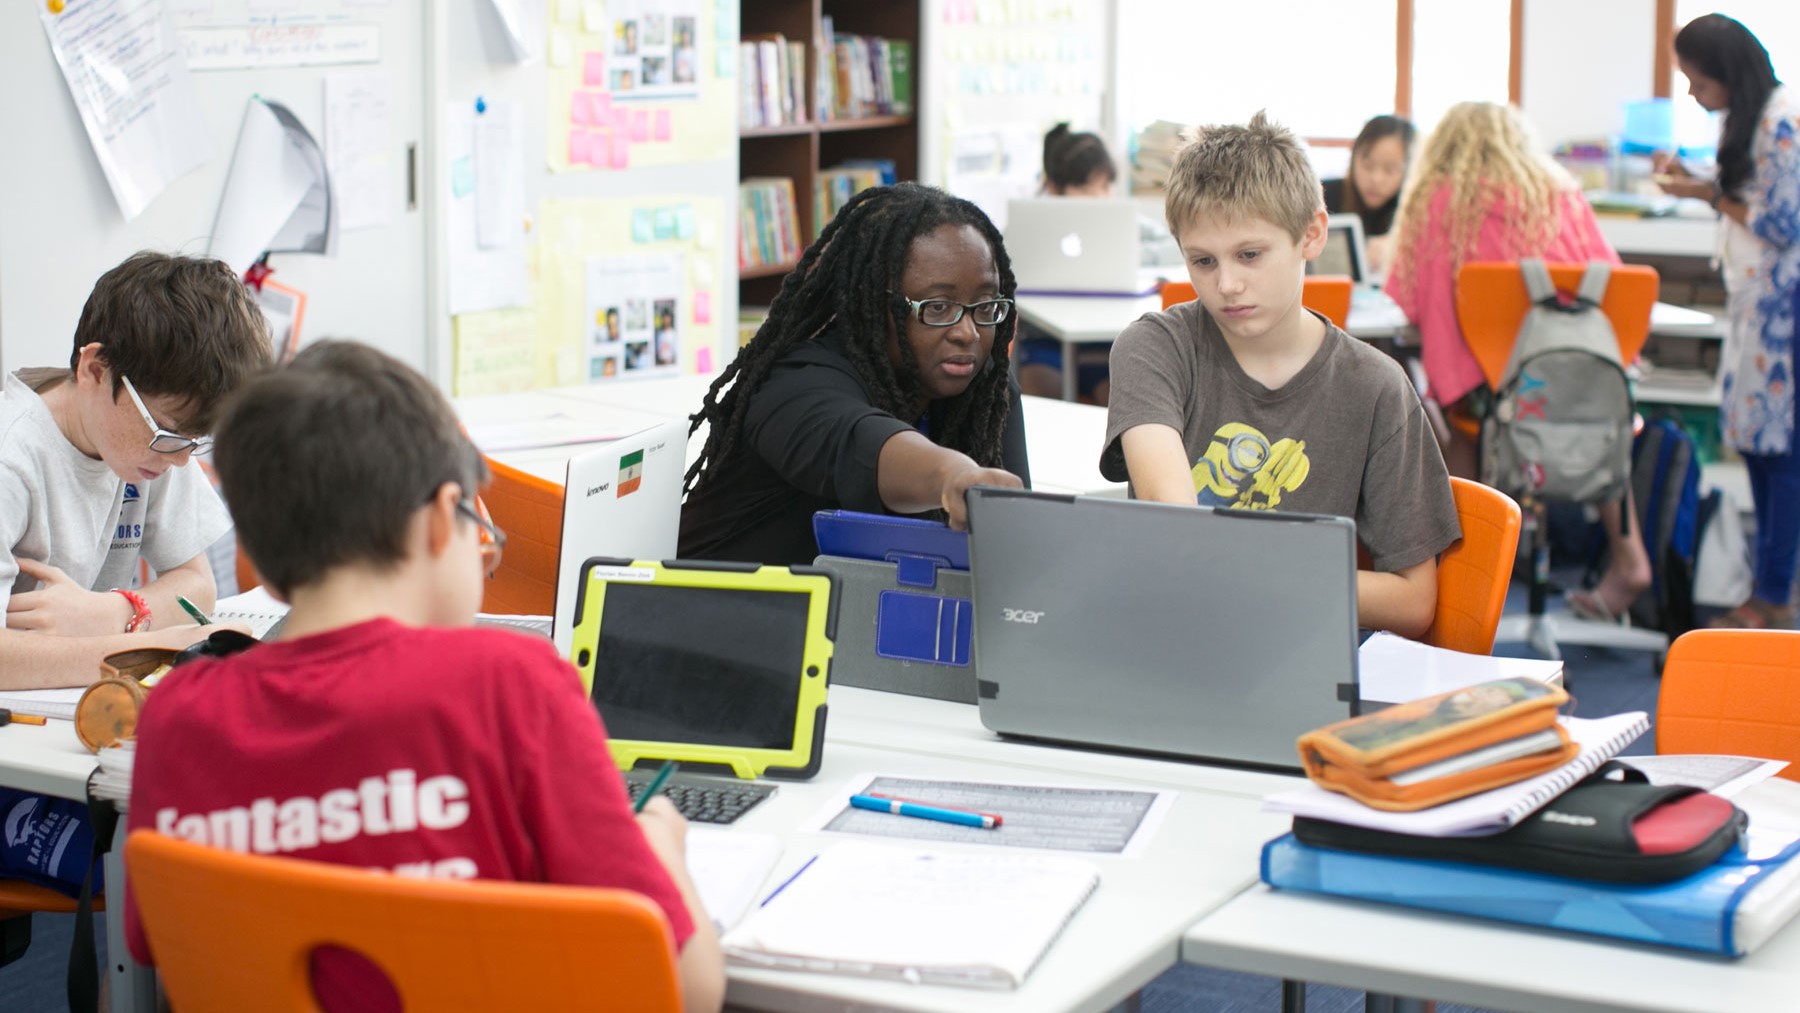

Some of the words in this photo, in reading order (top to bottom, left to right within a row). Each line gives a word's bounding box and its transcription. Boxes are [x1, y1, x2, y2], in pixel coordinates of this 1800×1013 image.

[113, 524, 141, 539] ORS
[1003, 607, 1045, 624] acer
[26, 811, 60, 866] RAPTORS
